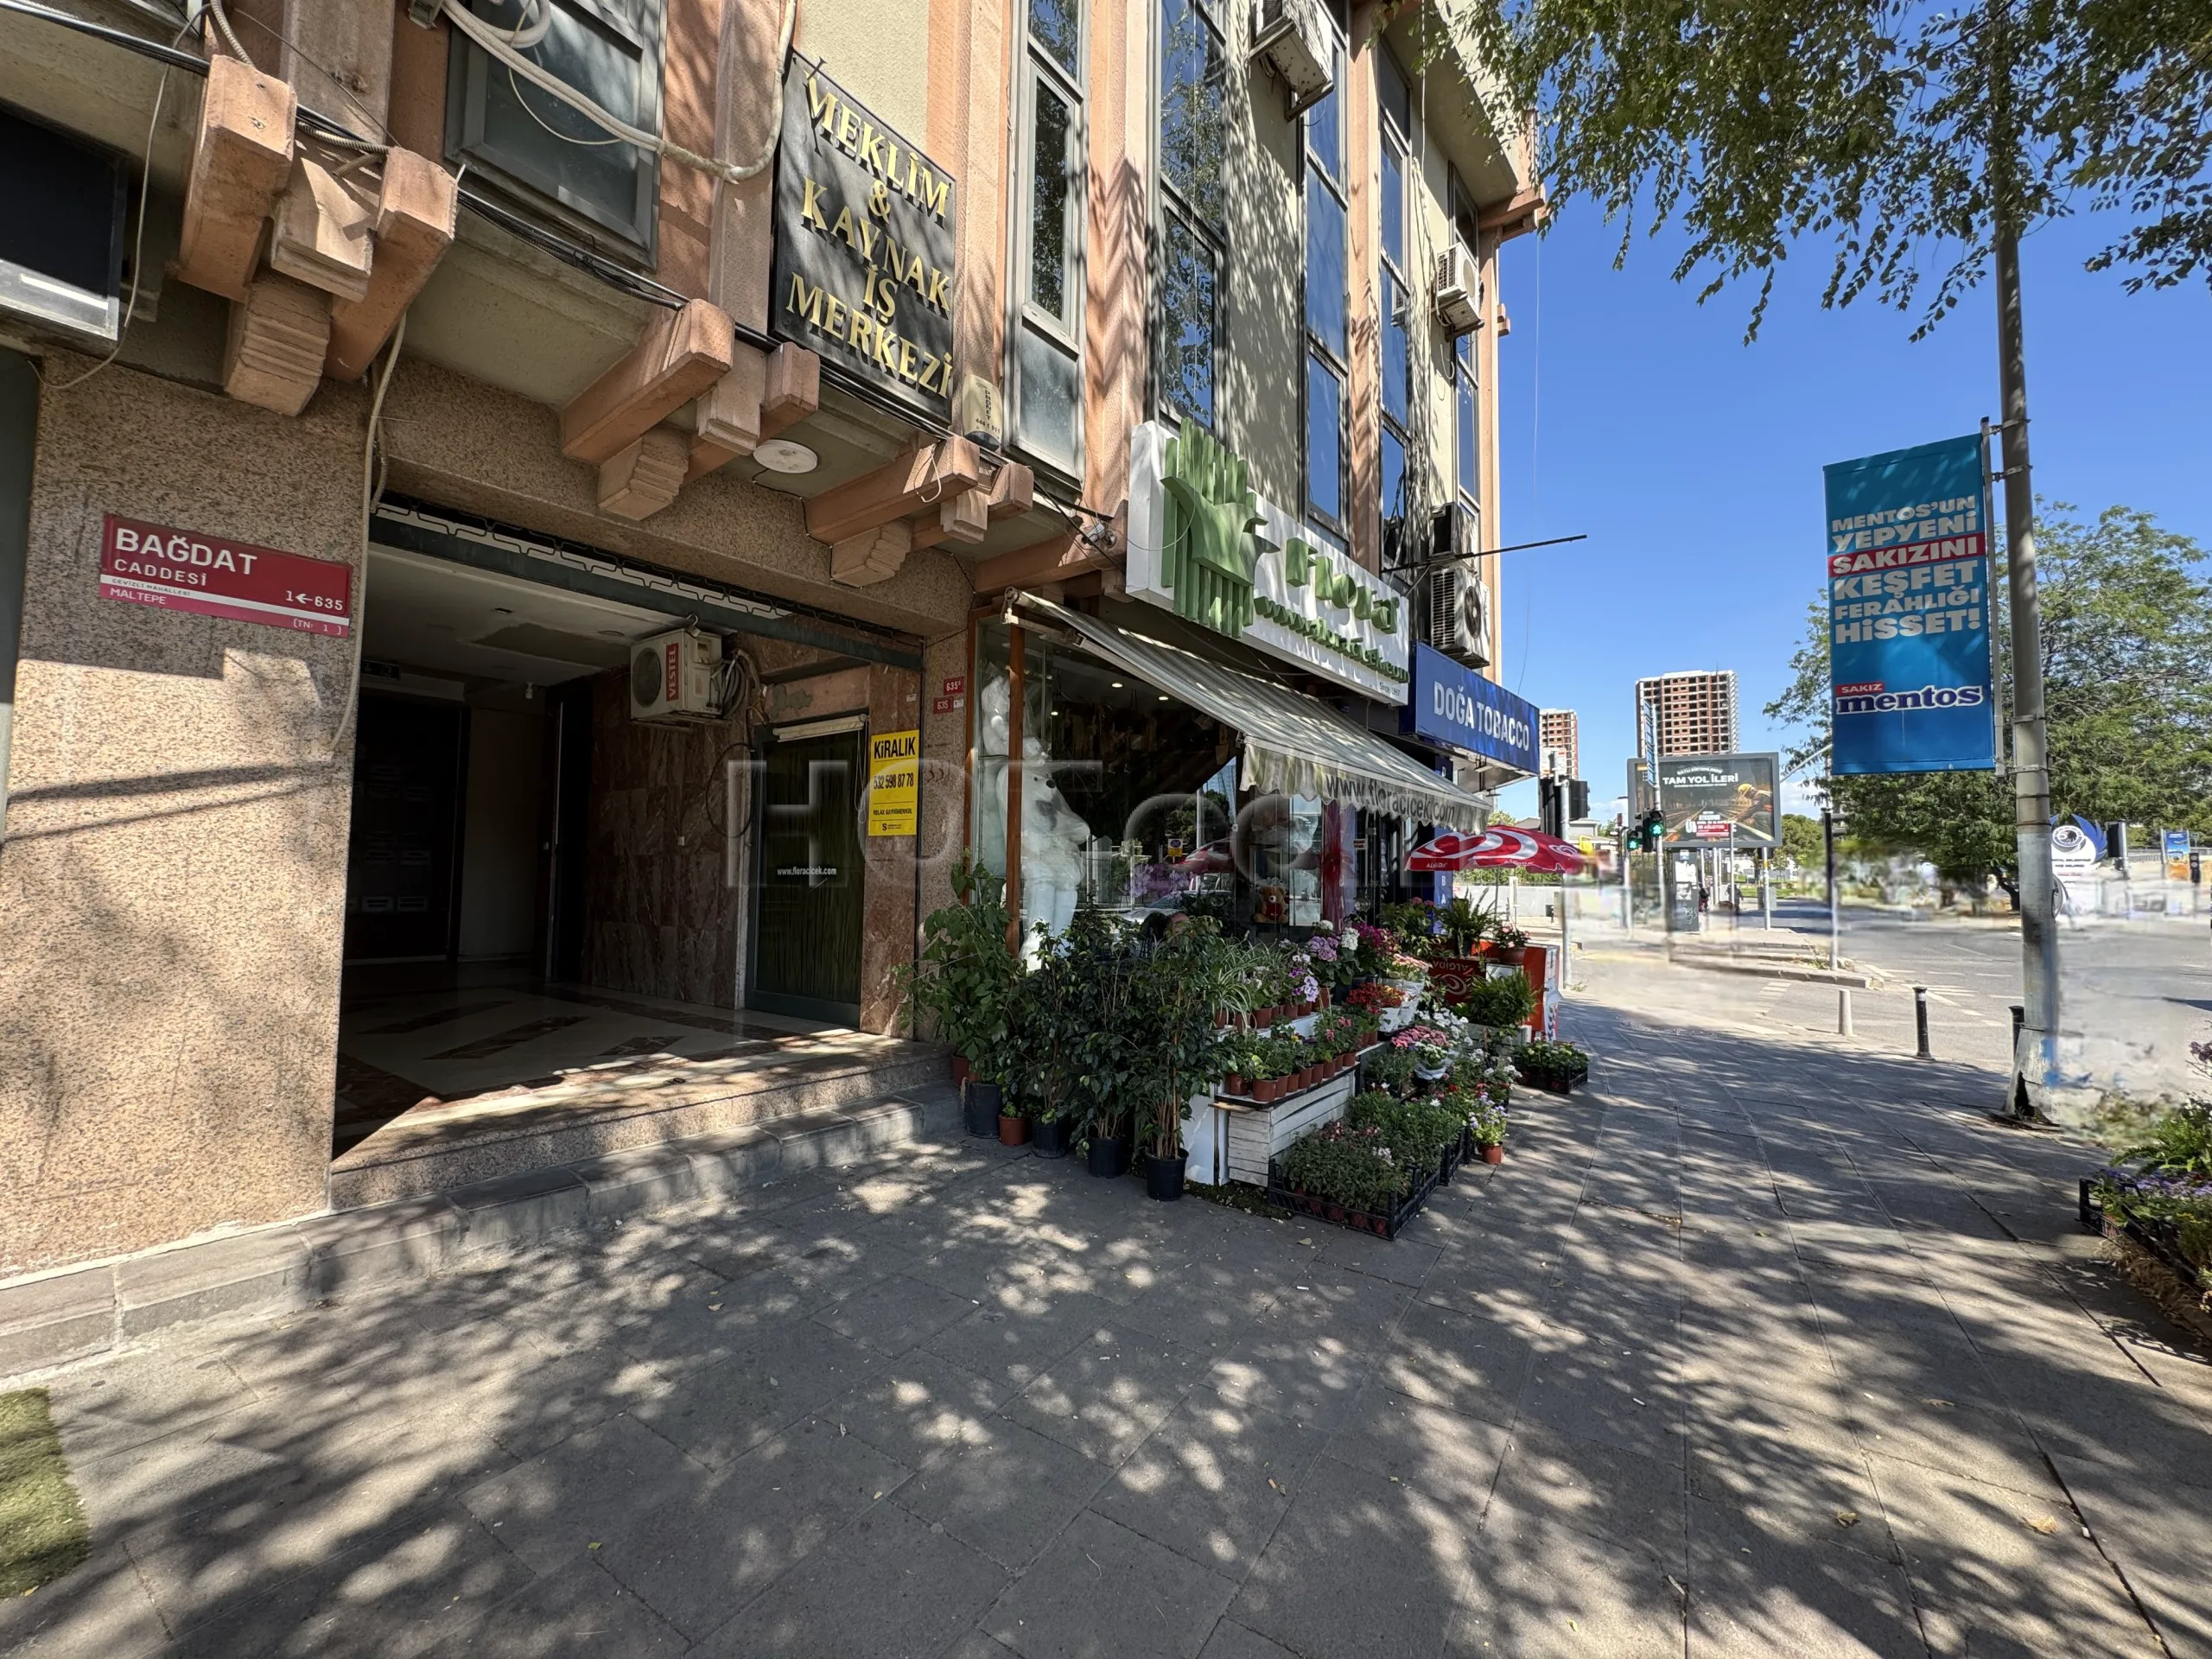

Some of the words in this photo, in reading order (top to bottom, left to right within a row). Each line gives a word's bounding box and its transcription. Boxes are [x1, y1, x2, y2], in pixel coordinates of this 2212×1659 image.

[868, 179, 892, 224] &
[801, 175, 950, 312] KAYNAK
[862, 264, 899, 326] İŞ
[785, 271, 953, 398] MERKEZİ
[116, 528, 257, 575] BAĞDAT
[1833, 537, 1978, 574] SAKIZINI
[110, 588, 167, 605] MALTEPE
[1834, 560, 1978, 601] KEŞFET
[315, 596, 343, 610] 635
[1834, 584, 1980, 620] FERAHLIĞI
[668, 645, 677, 699] VESTEL
[1841, 683, 1883, 694] SAKIZ
[1433, 681, 1475, 729] DOĞA
[1476, 702, 1529, 751] TOBACCO
[1837, 685, 1983, 715] mentos
[897, 772, 906, 788] 87
[906, 772, 914, 787] 78
[1662, 776, 1686, 785] TAM
[1688, 775, 1710, 785] YOL
[1711, 772, 1738, 783] İLERİ
